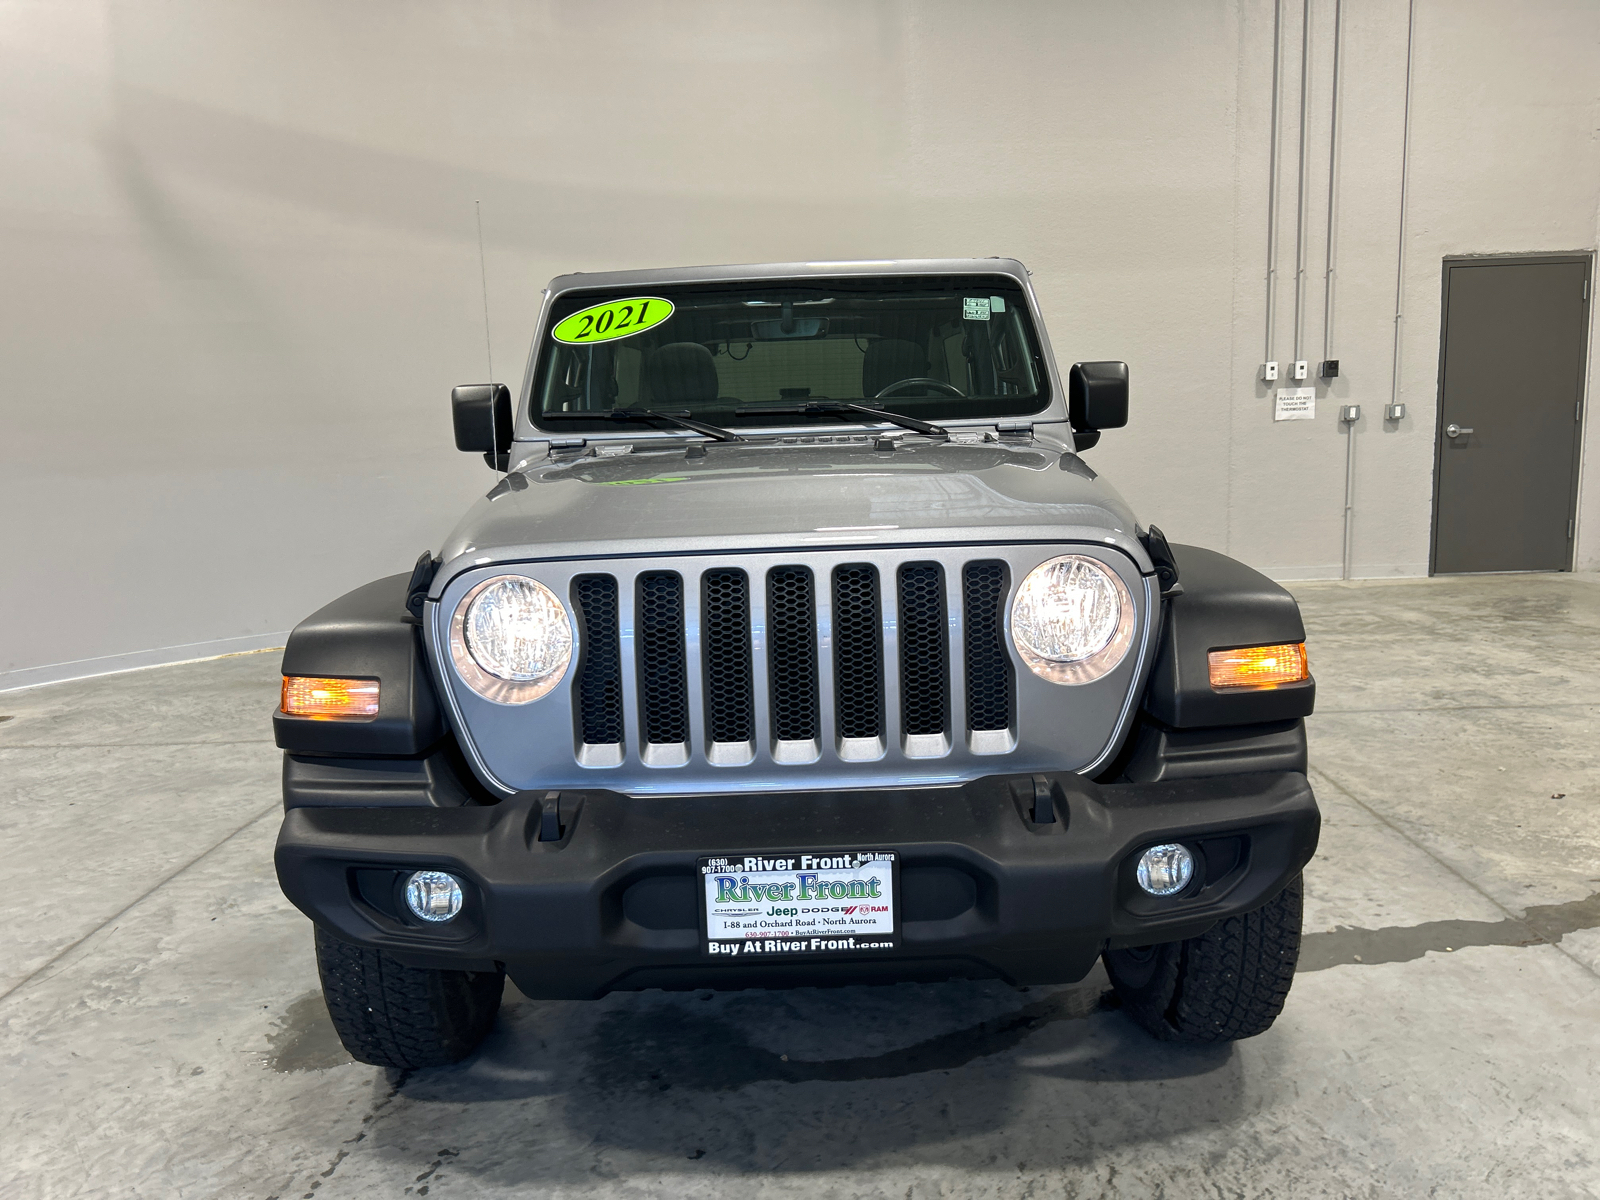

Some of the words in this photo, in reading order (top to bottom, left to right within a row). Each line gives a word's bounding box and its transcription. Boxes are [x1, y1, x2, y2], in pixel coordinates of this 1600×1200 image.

[574, 301, 650, 339] 2021
[708, 858, 728, 866] (630)
[743, 856, 795, 872] River
[800, 854, 852, 870] Front
[857, 852, 874, 862] North
[874, 852, 895, 861] Aurora
[702, 864, 735, 874] 907-1700
[714, 876, 796, 903] River
[796, 872, 882, 900] Front
[766, 906, 798, 918] Jeep
[742, 920, 758, 928] and
[760, 919, 793, 928] Orchard
[796, 918, 816, 926] Road
[822, 917, 846, 926] North
[848, 917, 877, 925] Aurora
[708, 942, 740, 956] Buy
[743, 940, 762, 953] At
[764, 940, 808, 952] River
[810, 938, 894, 950] Front.com
